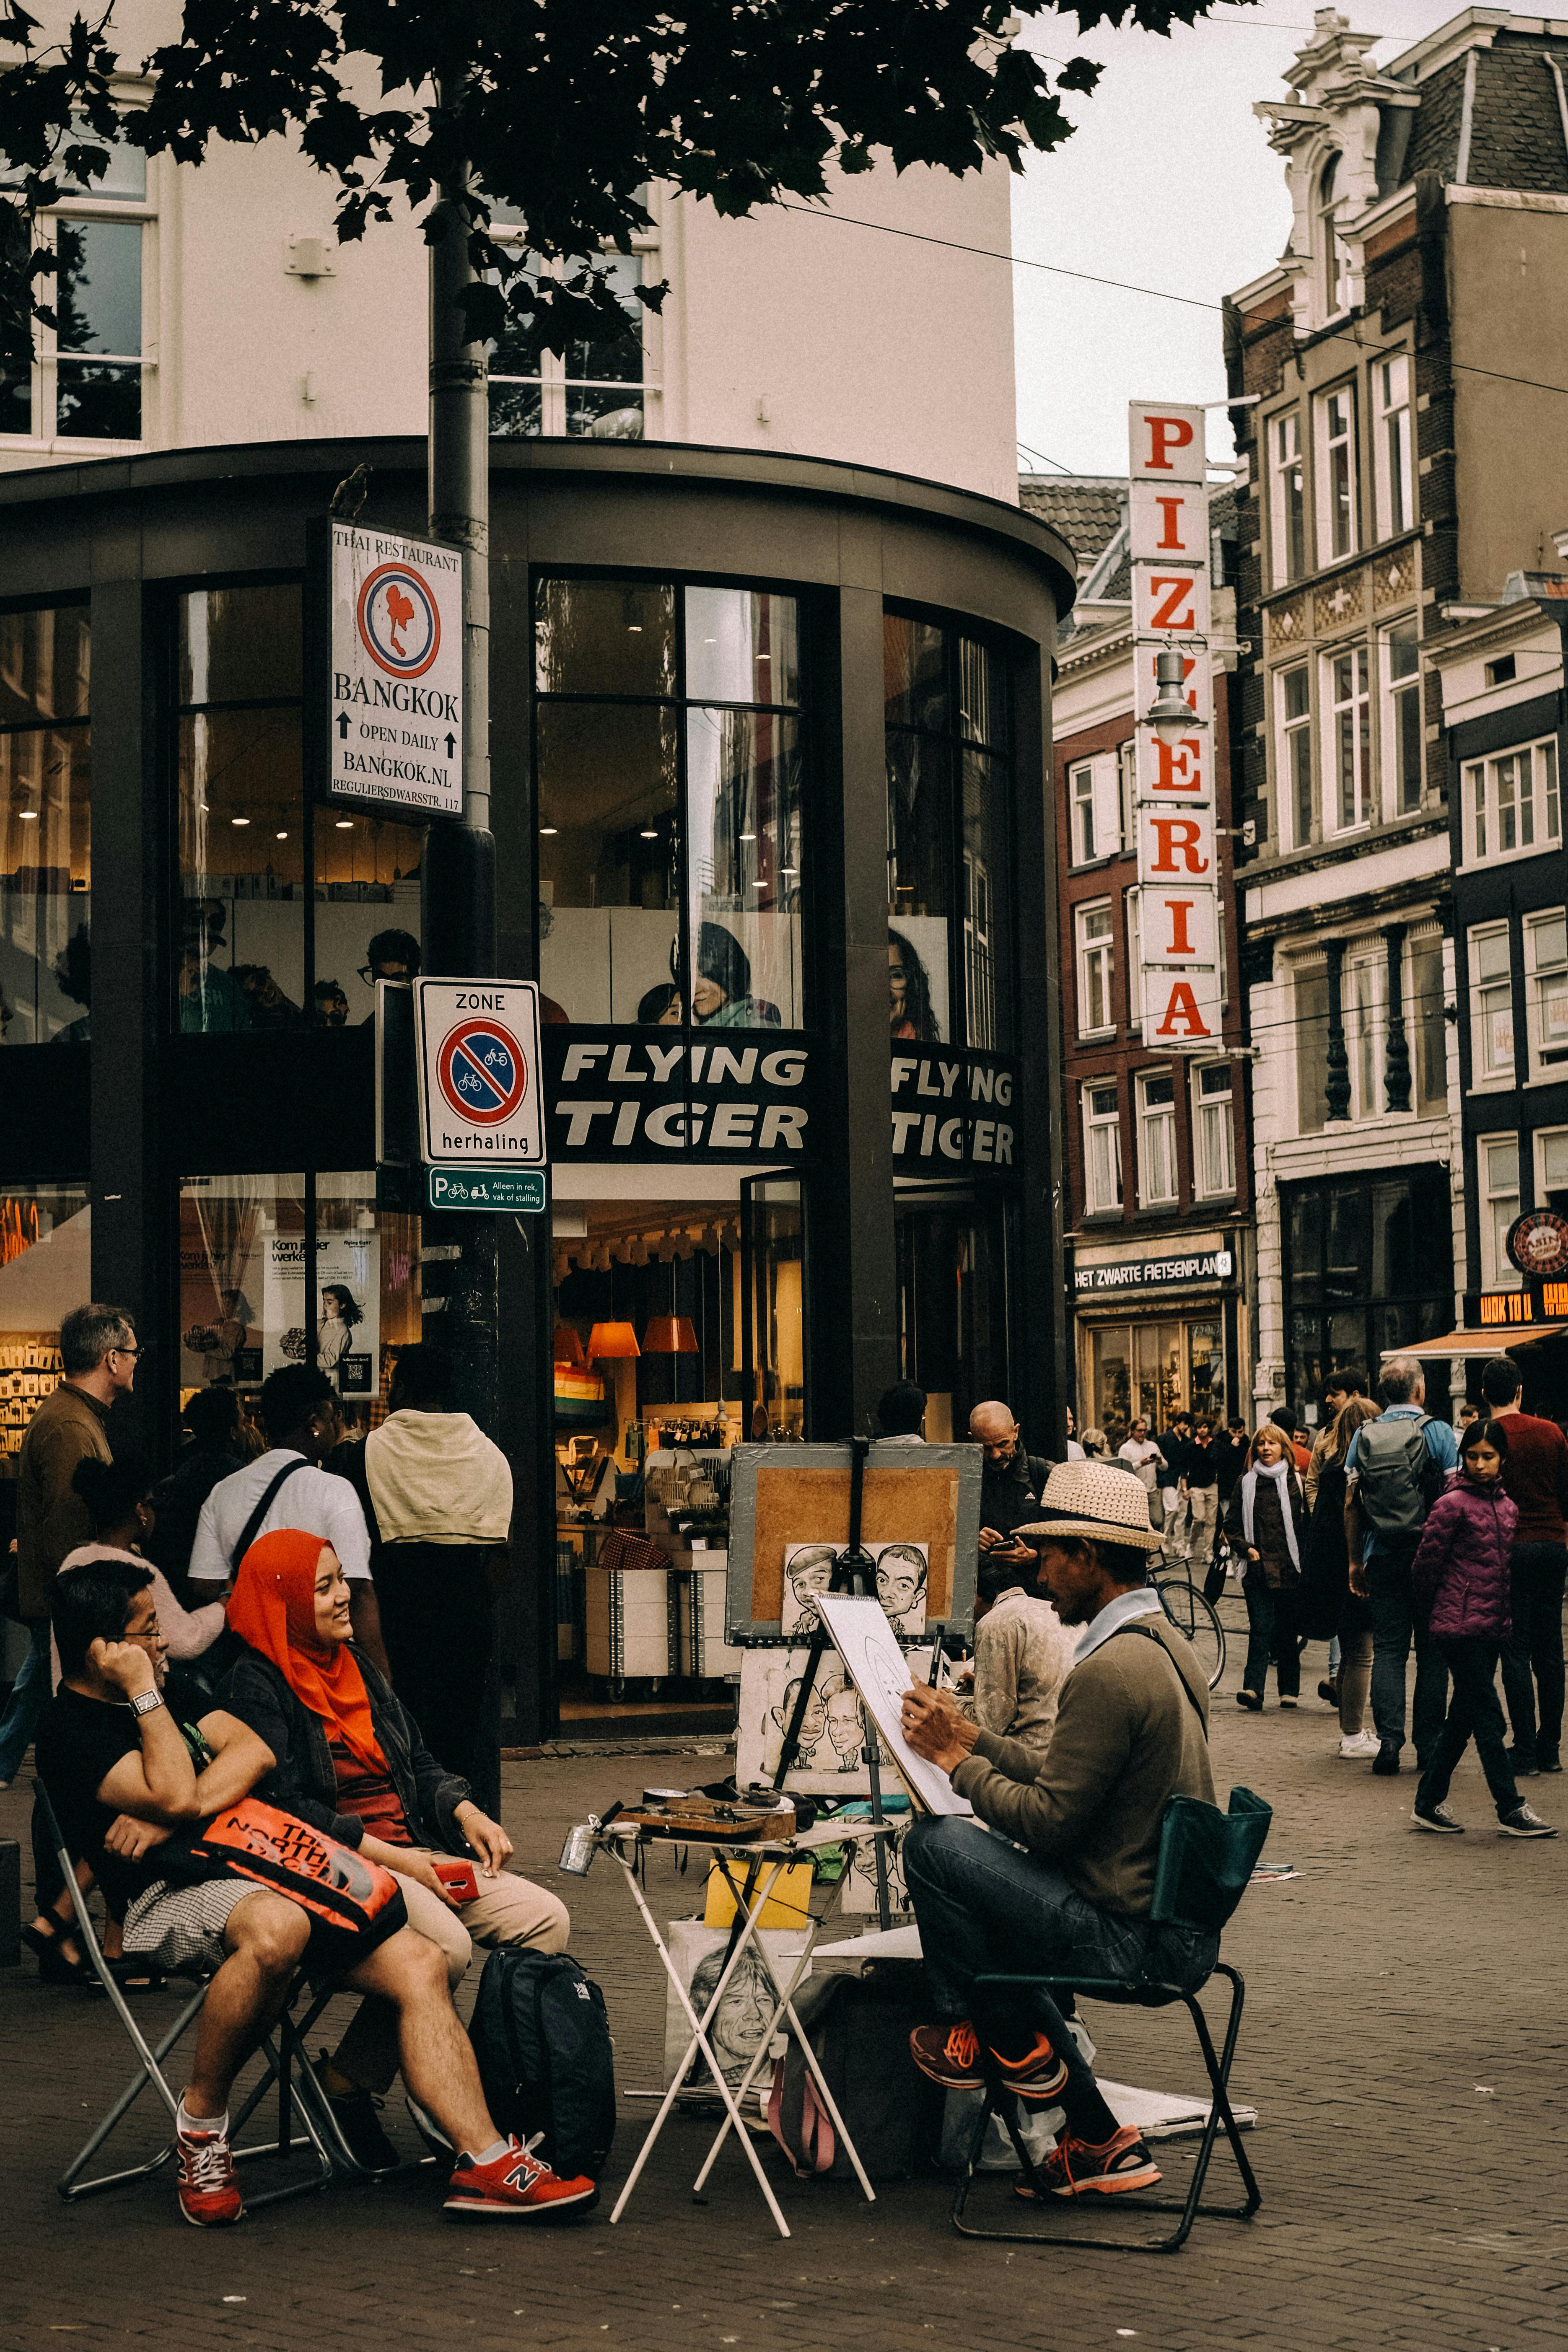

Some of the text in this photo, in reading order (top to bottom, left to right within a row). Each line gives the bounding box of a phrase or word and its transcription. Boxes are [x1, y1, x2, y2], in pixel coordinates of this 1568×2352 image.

[334, 531, 459, 572] THAI RESTAURANT
[334, 673, 459, 723] BANGKOK
[360, 724, 439, 751] OPEN DAILY
[344, 751, 452, 788] BANGKOK.NL
[333, 779, 459, 810] REGULIERSDWARSSTR. 117
[456, 993, 505, 1010] ZONE
[561, 1044, 1012, 1106] FLYING FLYNG
[443, 1132, 528, 1155] herhaling
[555, 1101, 1013, 1165] TIGER TIGER
[435, 1177, 448, 1198] P
[492, 1181, 514, 1190] Alleen
[524, 1183, 537, 1192] rek,
[516, 1194, 540, 1204] stalling
[272, 1240, 298, 1251] Kom
[316, 1239, 330, 1250] ier
[1074, 1256, 1217, 1288] HET ZWARTE FIETSENPLAN
[1480, 1293, 1532, 1324] WOK TO U
[1544, 1303, 1555, 1316] TO
[503, 2163, 541, 2193] N
